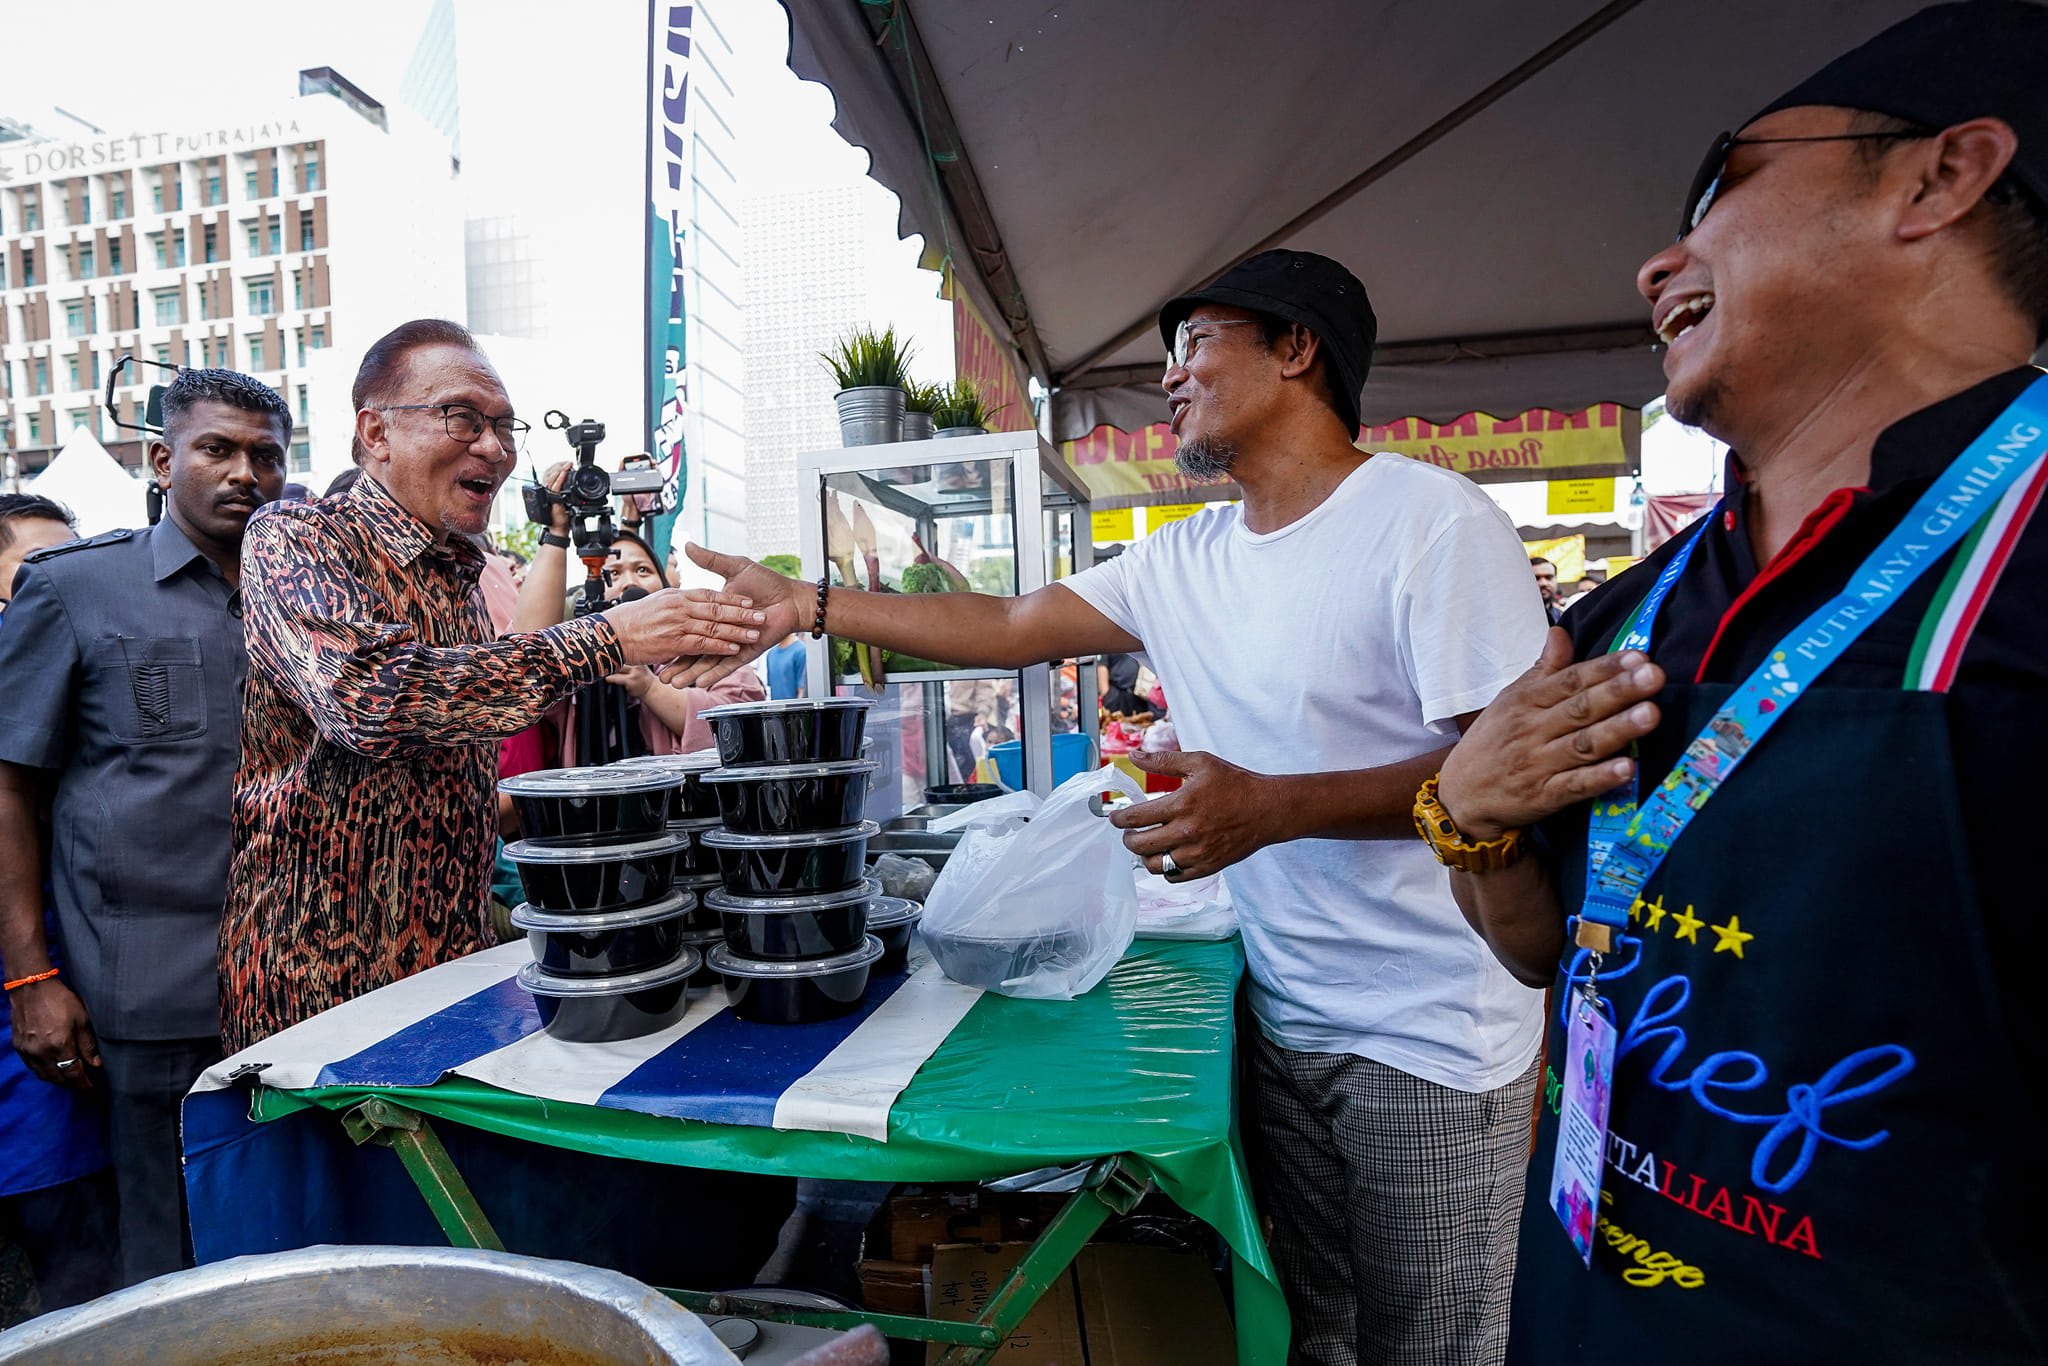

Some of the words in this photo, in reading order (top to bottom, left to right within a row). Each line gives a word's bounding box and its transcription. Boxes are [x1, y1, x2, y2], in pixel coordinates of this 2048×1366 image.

[25, 131, 169, 175] DORSETT
[176, 119, 300, 153] PUTRAJAYA
[1796, 543, 1930, 660] PUTRAJAYA
[1922, 422, 2042, 536] GEMILANG
